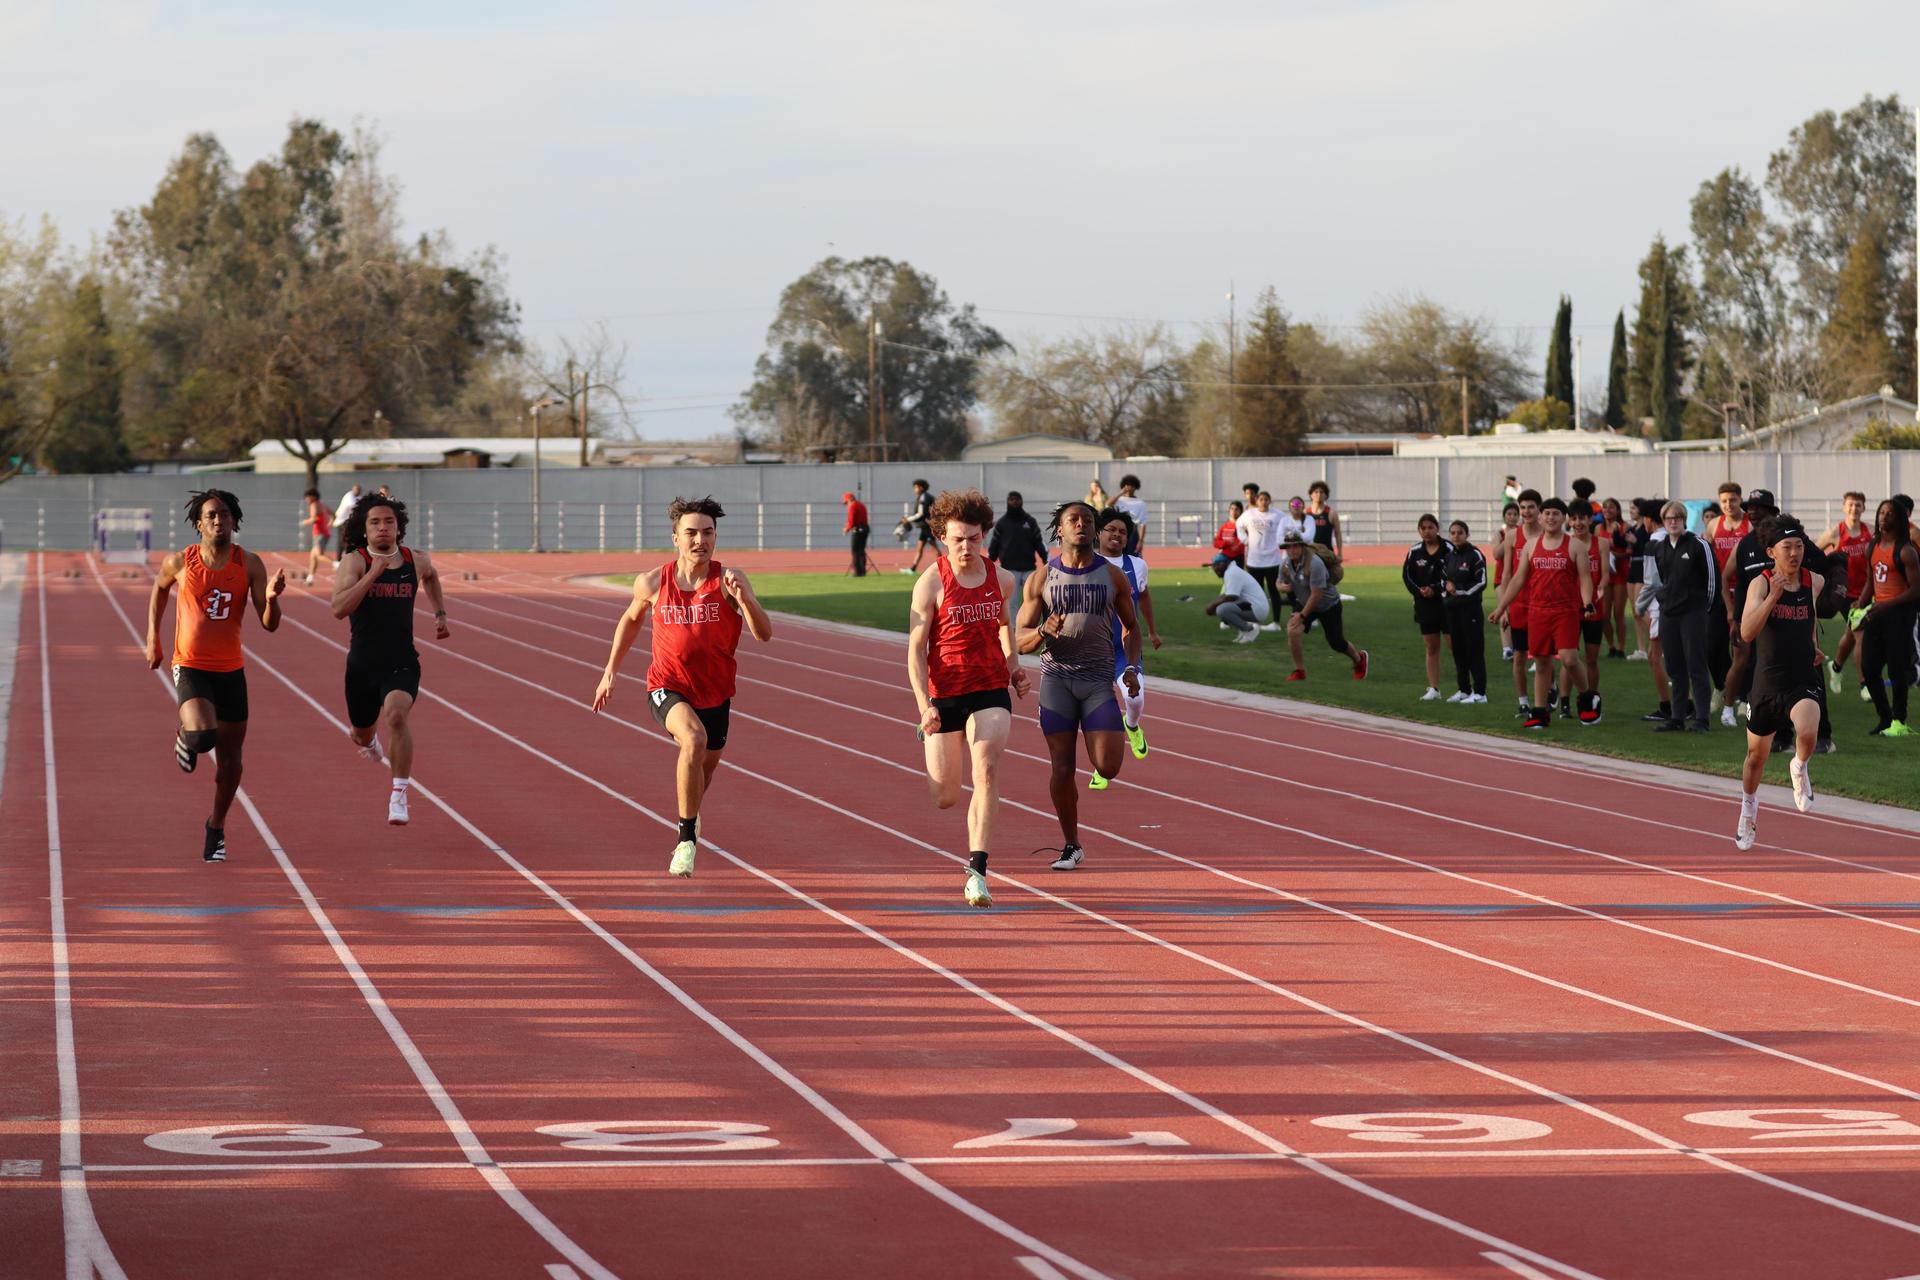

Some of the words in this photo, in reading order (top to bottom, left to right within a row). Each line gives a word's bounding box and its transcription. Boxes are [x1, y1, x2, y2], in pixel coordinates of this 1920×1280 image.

[1533, 557, 1567, 569] TRIBE
[369, 583, 413, 598] FOWLER
[1050, 583, 1107, 616] WASHINGTON
[660, 602, 720, 625] TRIBE
[534, 1119, 781, 1153] 8
[952, 1116, 1191, 1149] 7
